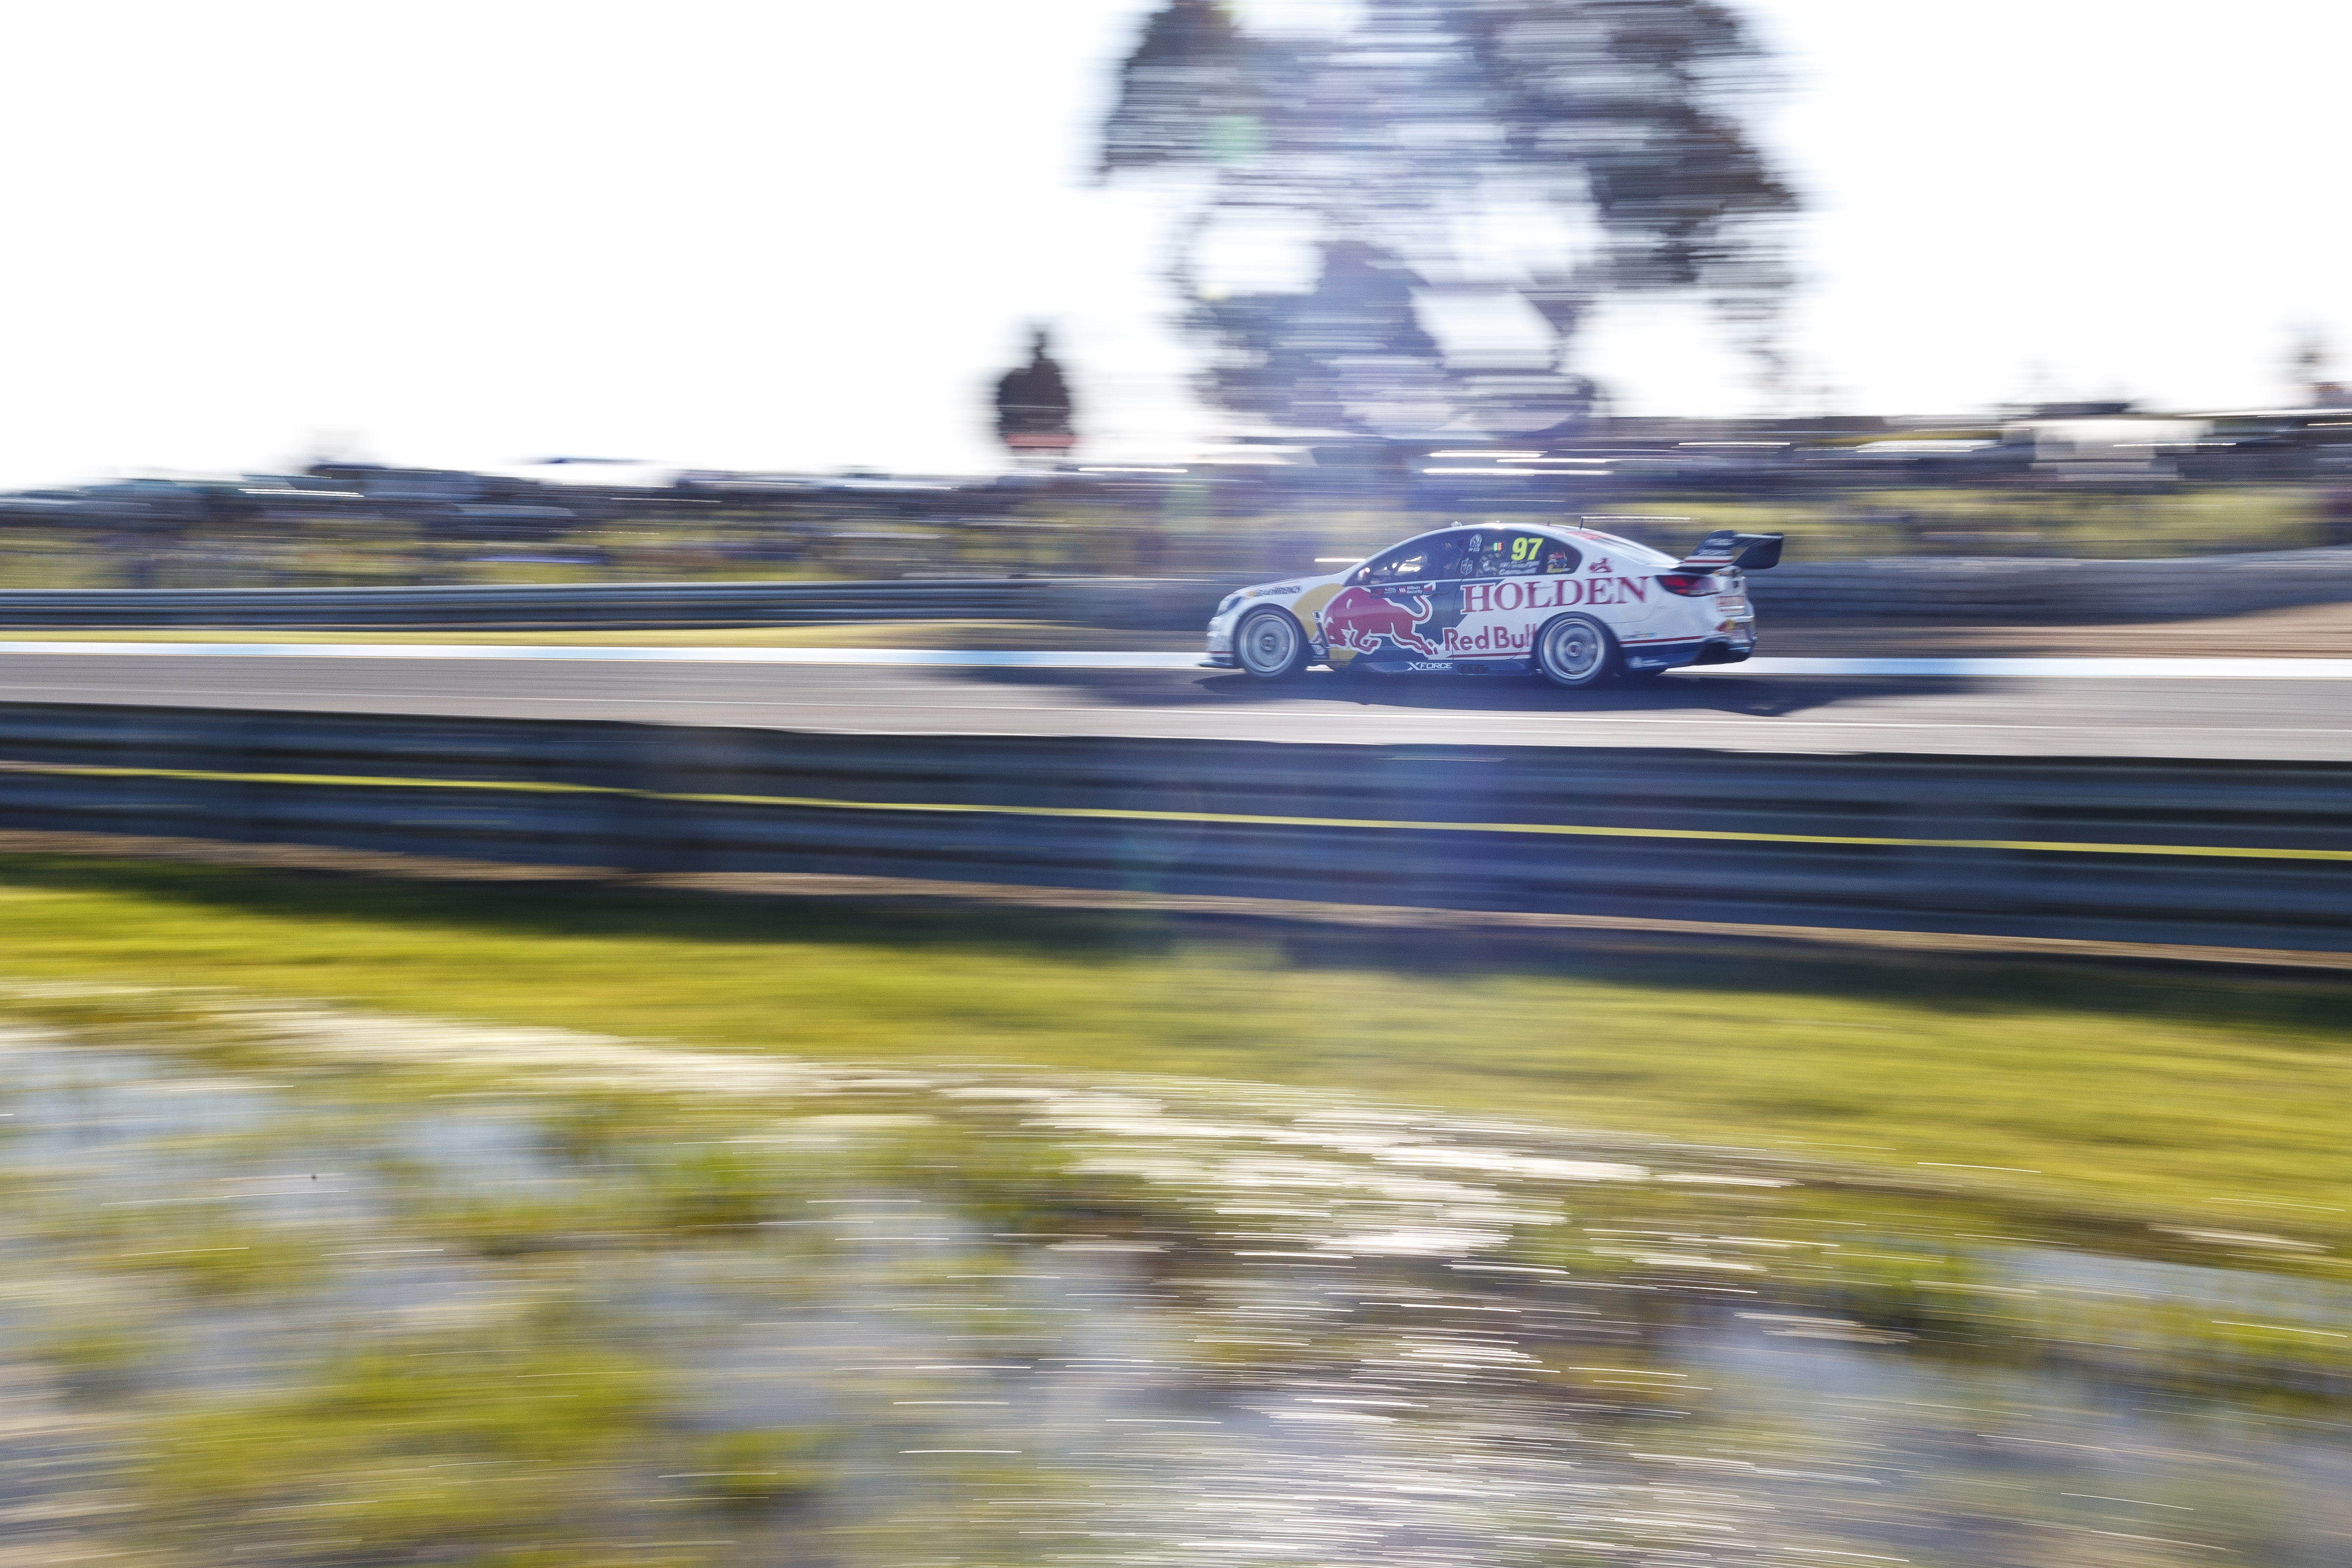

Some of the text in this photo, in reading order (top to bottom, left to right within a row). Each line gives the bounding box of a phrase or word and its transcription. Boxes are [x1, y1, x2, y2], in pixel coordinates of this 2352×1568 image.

[1511, 537, 1543, 561] 97
[1462, 576, 1648, 613] HOLDEN
[1443, 625, 1490, 651] Red
[1405, 661, 1453, 671] XFORCE
